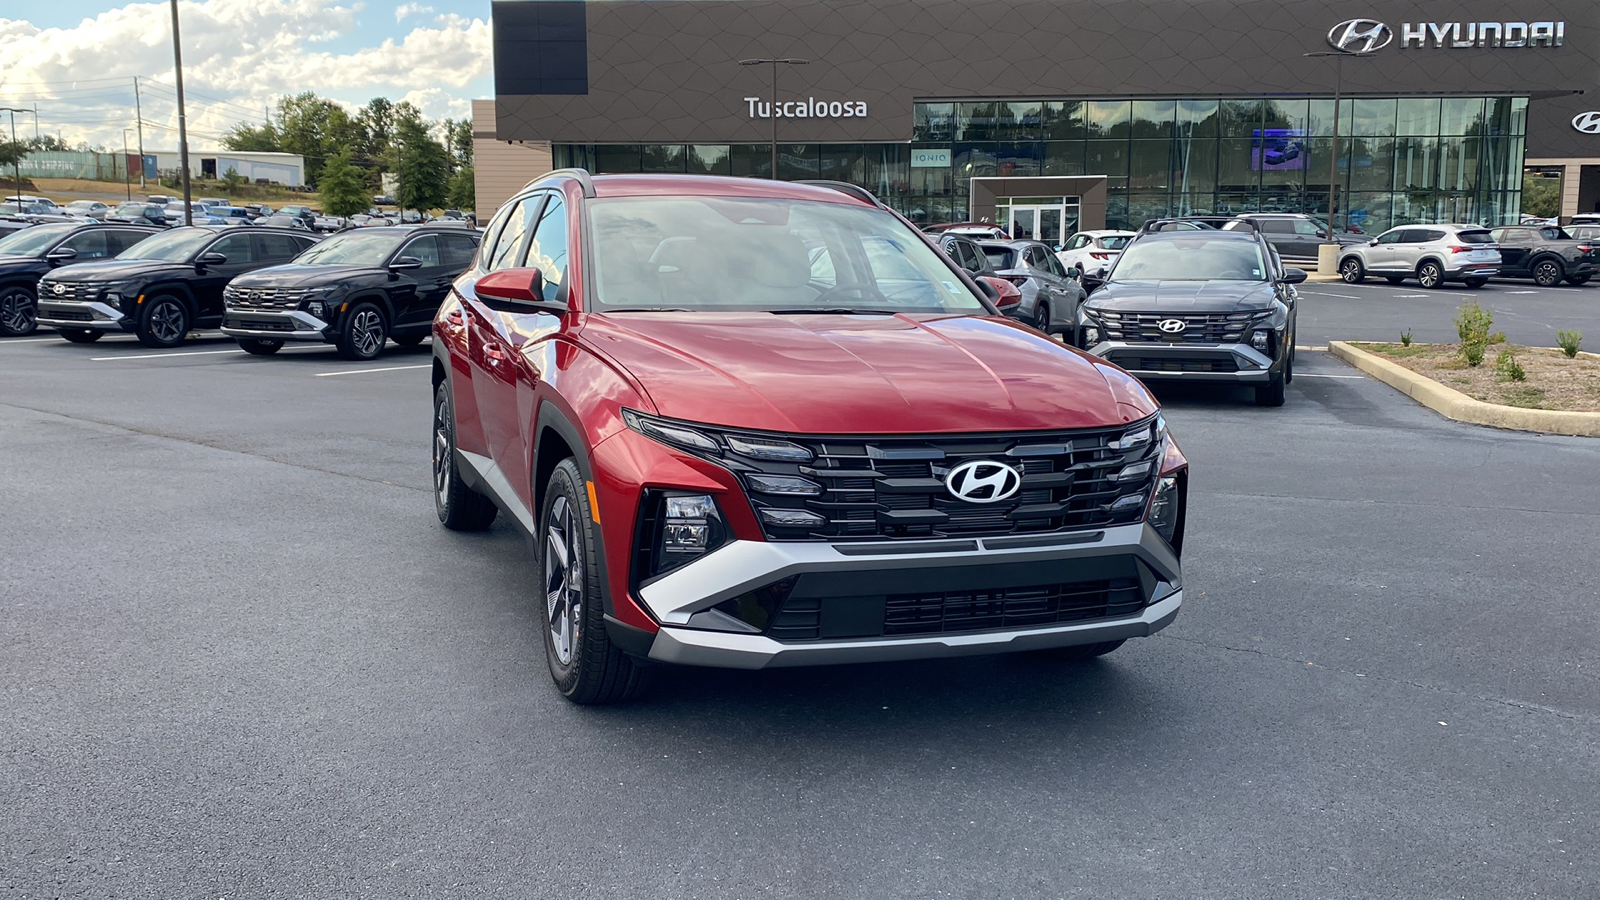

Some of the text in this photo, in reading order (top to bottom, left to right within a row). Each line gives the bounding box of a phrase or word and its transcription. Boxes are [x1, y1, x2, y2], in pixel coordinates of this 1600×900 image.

[1400, 21, 1565, 48] HYUNDAI
[744, 96, 867, 118] Tuscaloosa
[41, 160, 74, 170] SHIPPING
